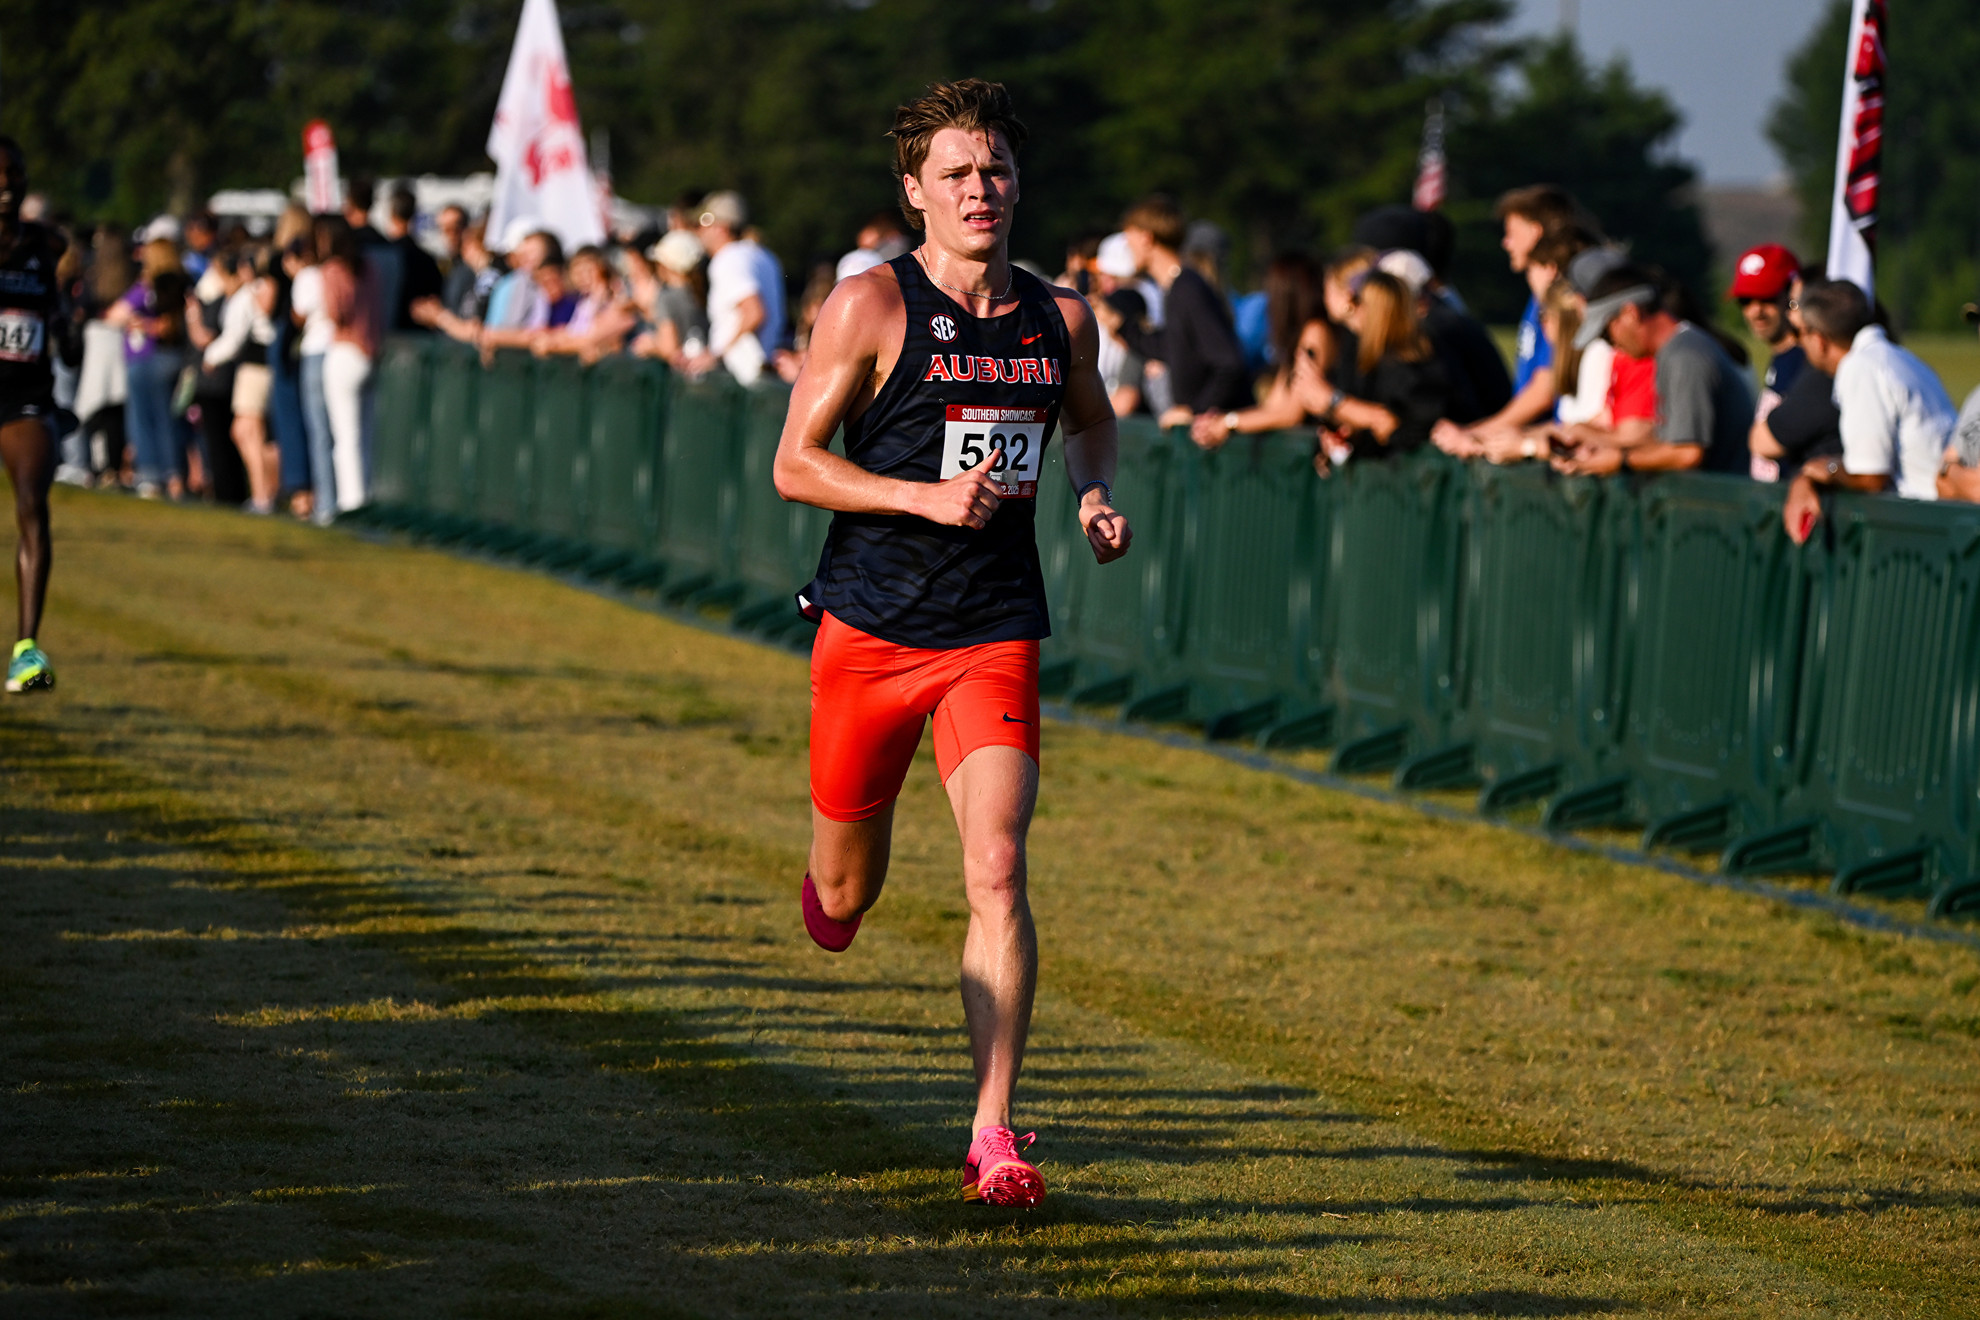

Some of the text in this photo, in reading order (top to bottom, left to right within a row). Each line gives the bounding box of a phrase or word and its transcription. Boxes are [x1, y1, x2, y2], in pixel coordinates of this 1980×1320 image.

[931, 315, 956, 341] SEC
[924, 354, 1062, 385] AUBURN
[962, 408, 1036, 421] SOUTHERN SHOWCASE
[959, 433, 1028, 472] 582
